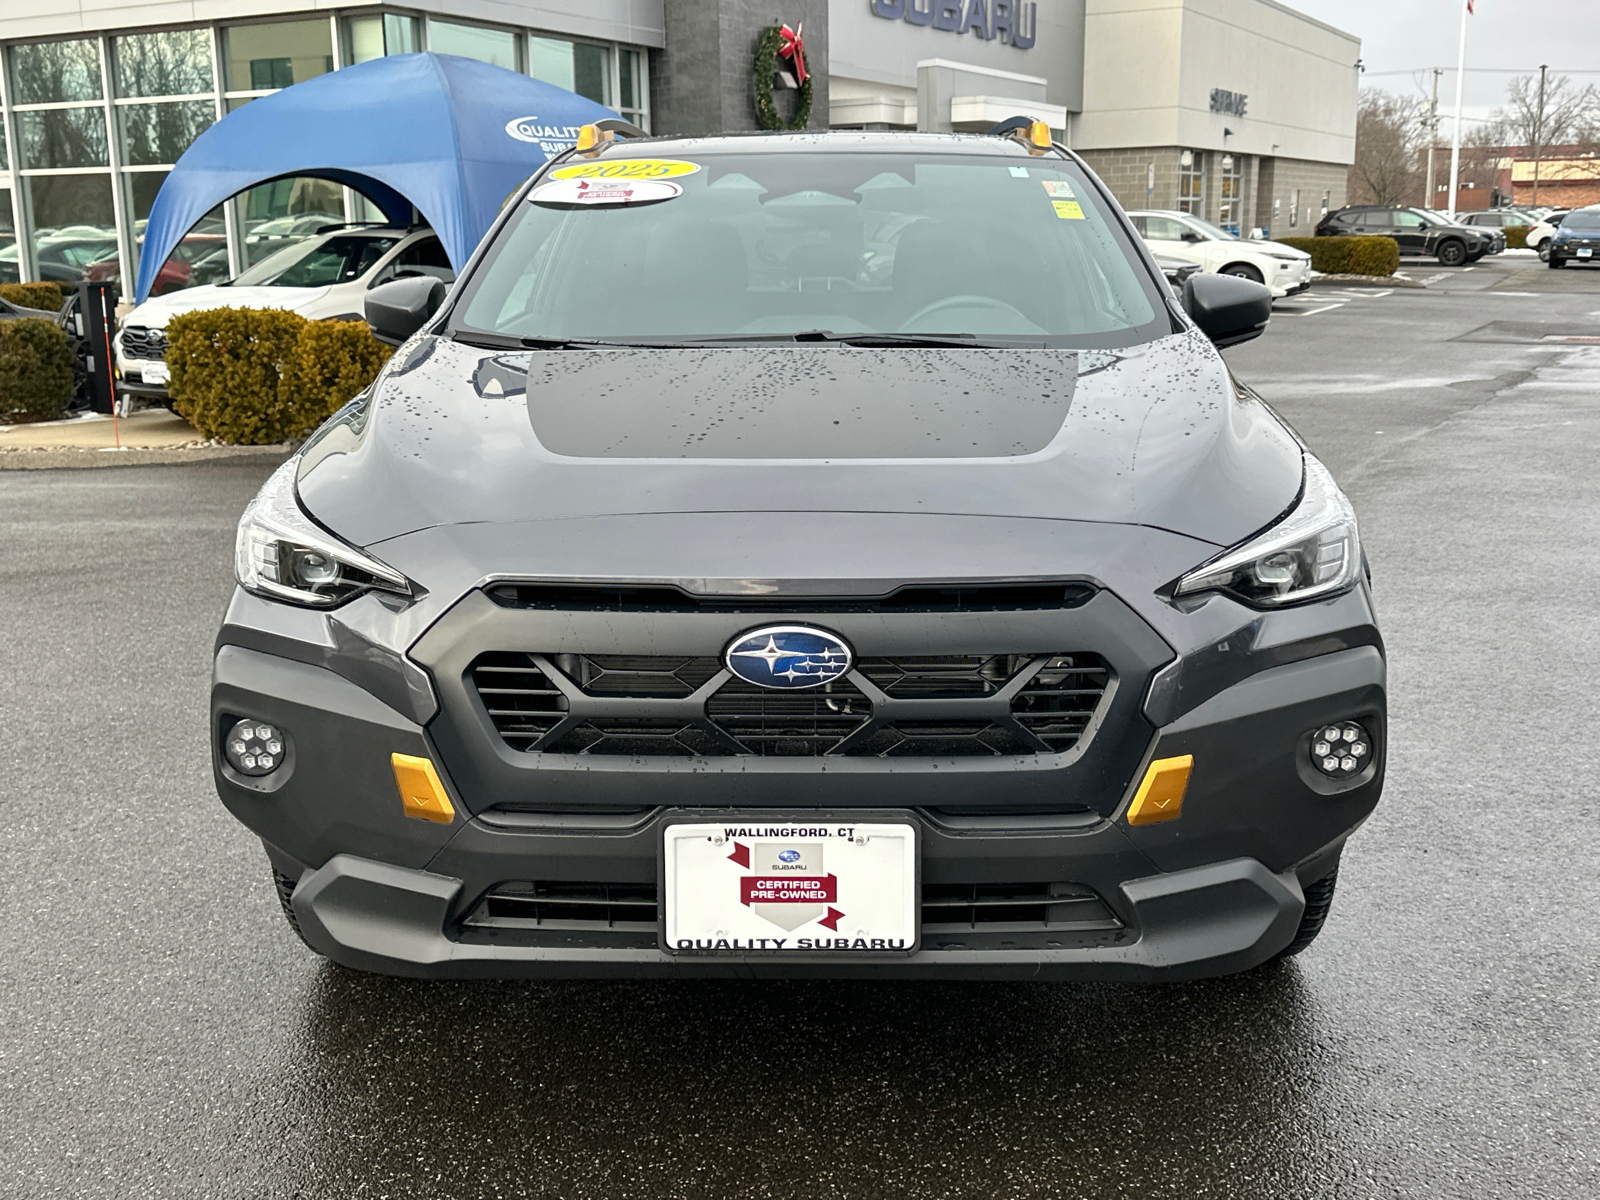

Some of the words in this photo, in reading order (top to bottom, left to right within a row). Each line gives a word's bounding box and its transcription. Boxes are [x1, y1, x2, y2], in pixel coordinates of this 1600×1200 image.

[571, 163, 678, 178] 2025
[724, 828, 832, 837] WALLINGFORD,
[837, 828, 855, 837] CT
[756, 880, 820, 889] CERTIFIED
[750, 891, 827, 899] PRE-OWNED
[677, 939, 787, 949] QUALITY
[797, 938, 905, 949] SUBARU
